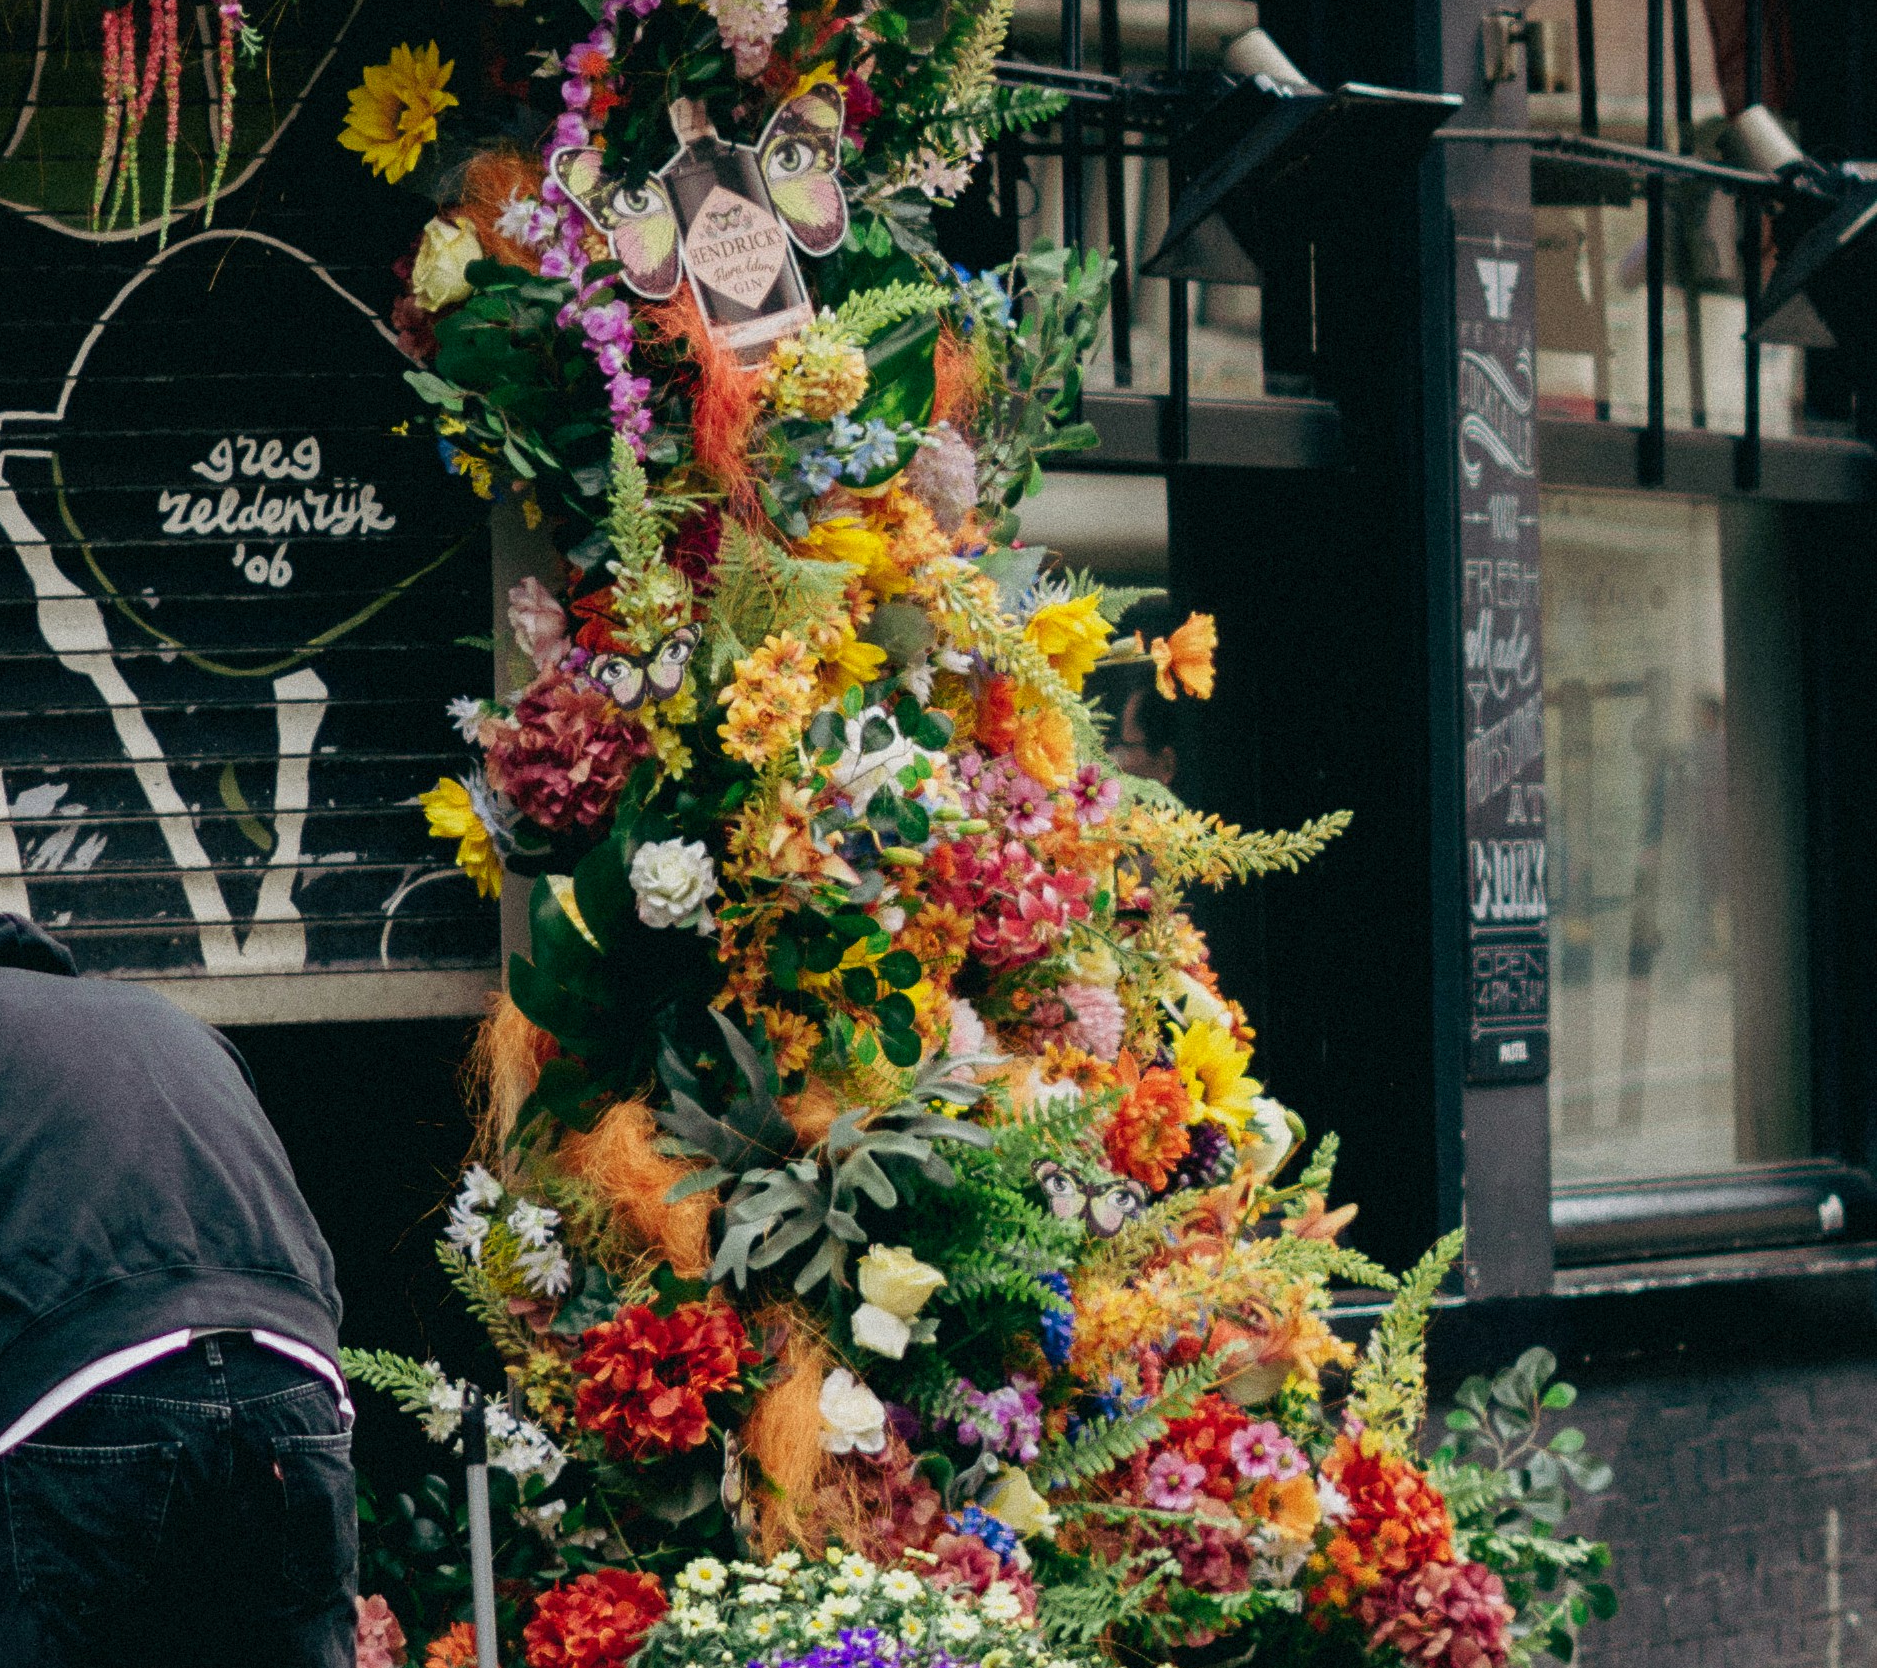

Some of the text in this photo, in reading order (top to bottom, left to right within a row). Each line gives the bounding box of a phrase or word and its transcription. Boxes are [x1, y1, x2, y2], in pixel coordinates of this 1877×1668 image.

[734, 276, 763, 295] GIN
[1465, 560, 1540, 607] FRESH
[1473, 951, 1545, 978] OPEN
